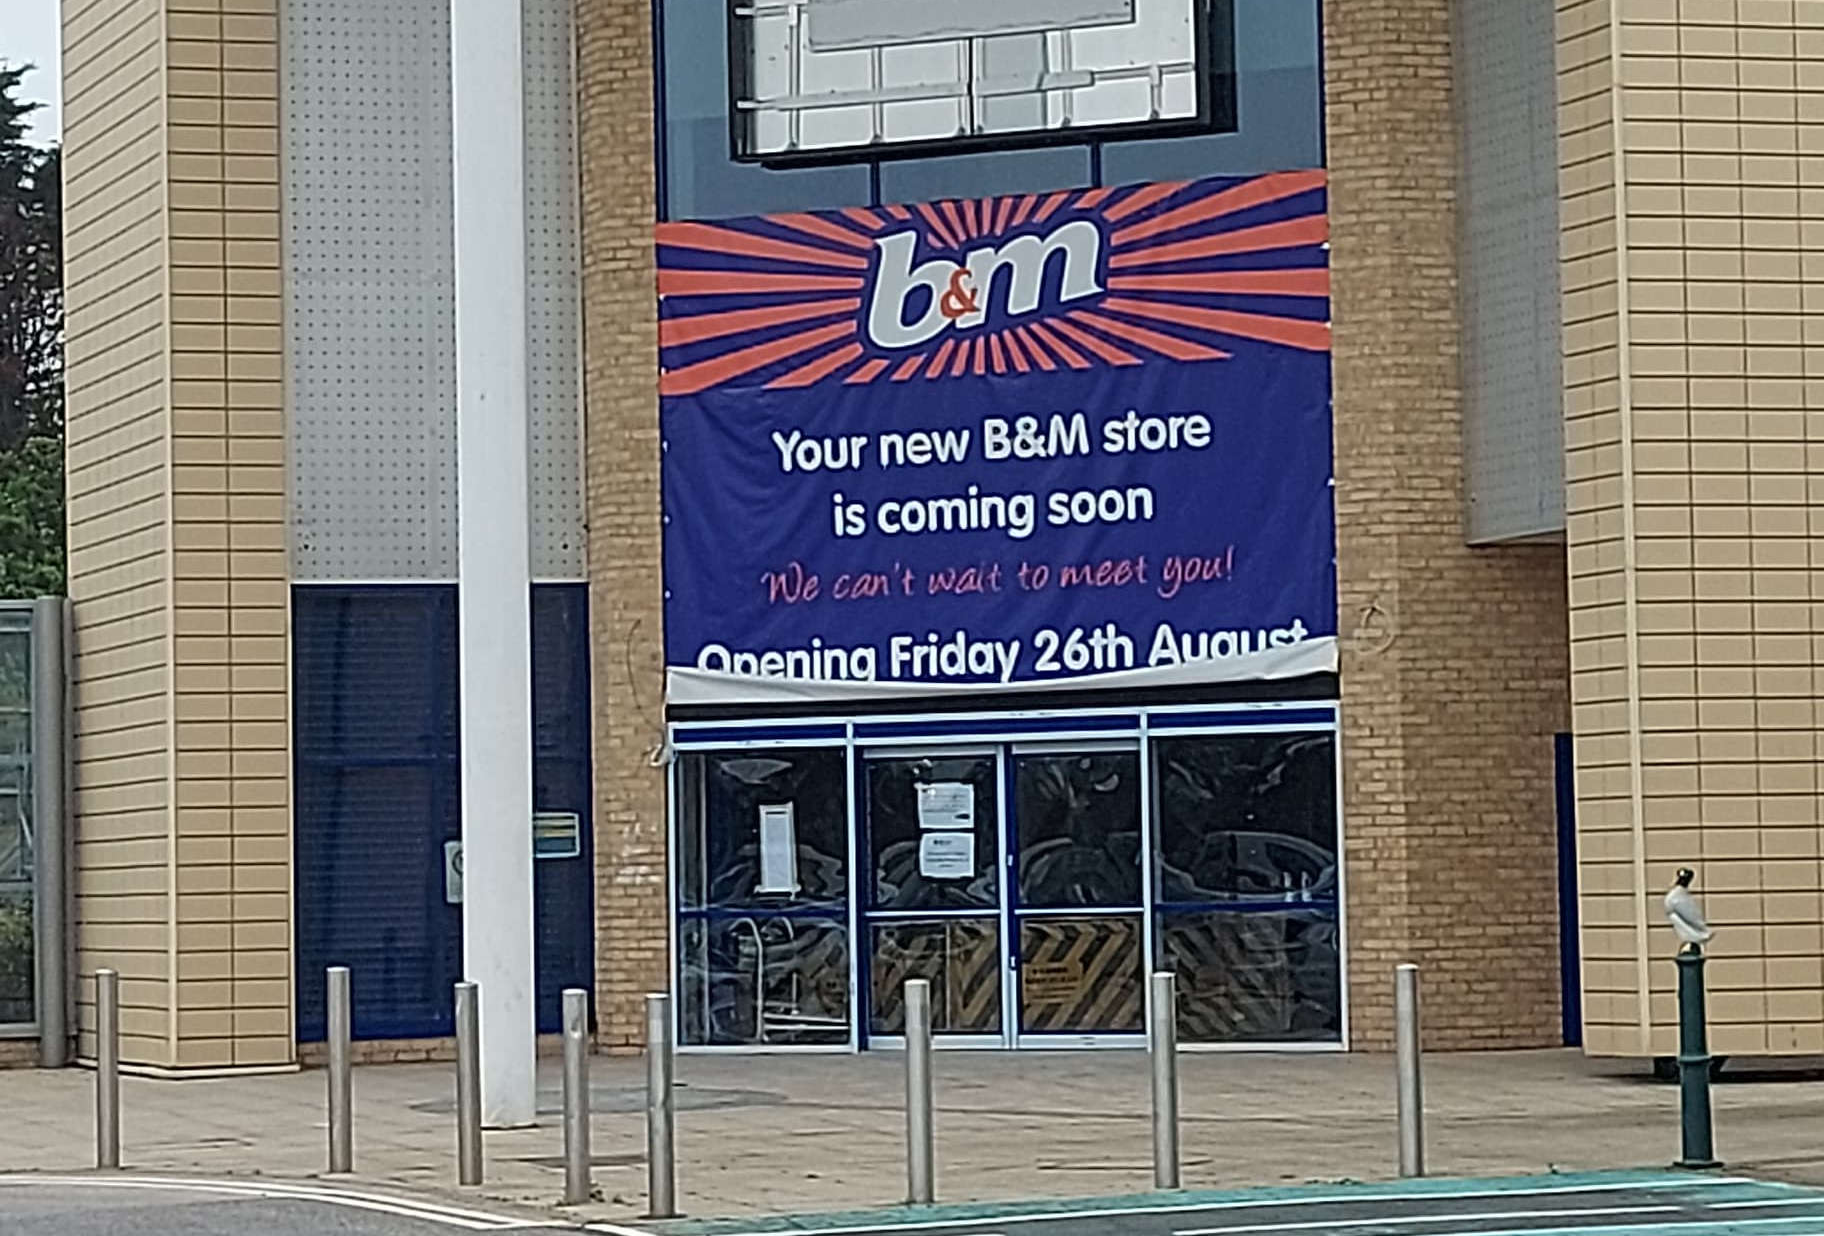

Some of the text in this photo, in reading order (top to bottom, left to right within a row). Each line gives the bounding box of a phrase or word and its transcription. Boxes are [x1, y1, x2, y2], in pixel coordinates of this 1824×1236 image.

[867, 220, 1104, 348] b&m
[772, 410, 1211, 472] Your new B&M store
[833, 485, 1153, 538] is coming soon
[761, 545, 1234, 604] We can't wait to meet you!
[698, 638, 876, 681] Opening
[891, 630, 1020, 682] Friday
[1034, 624, 1133, 671] 26th
